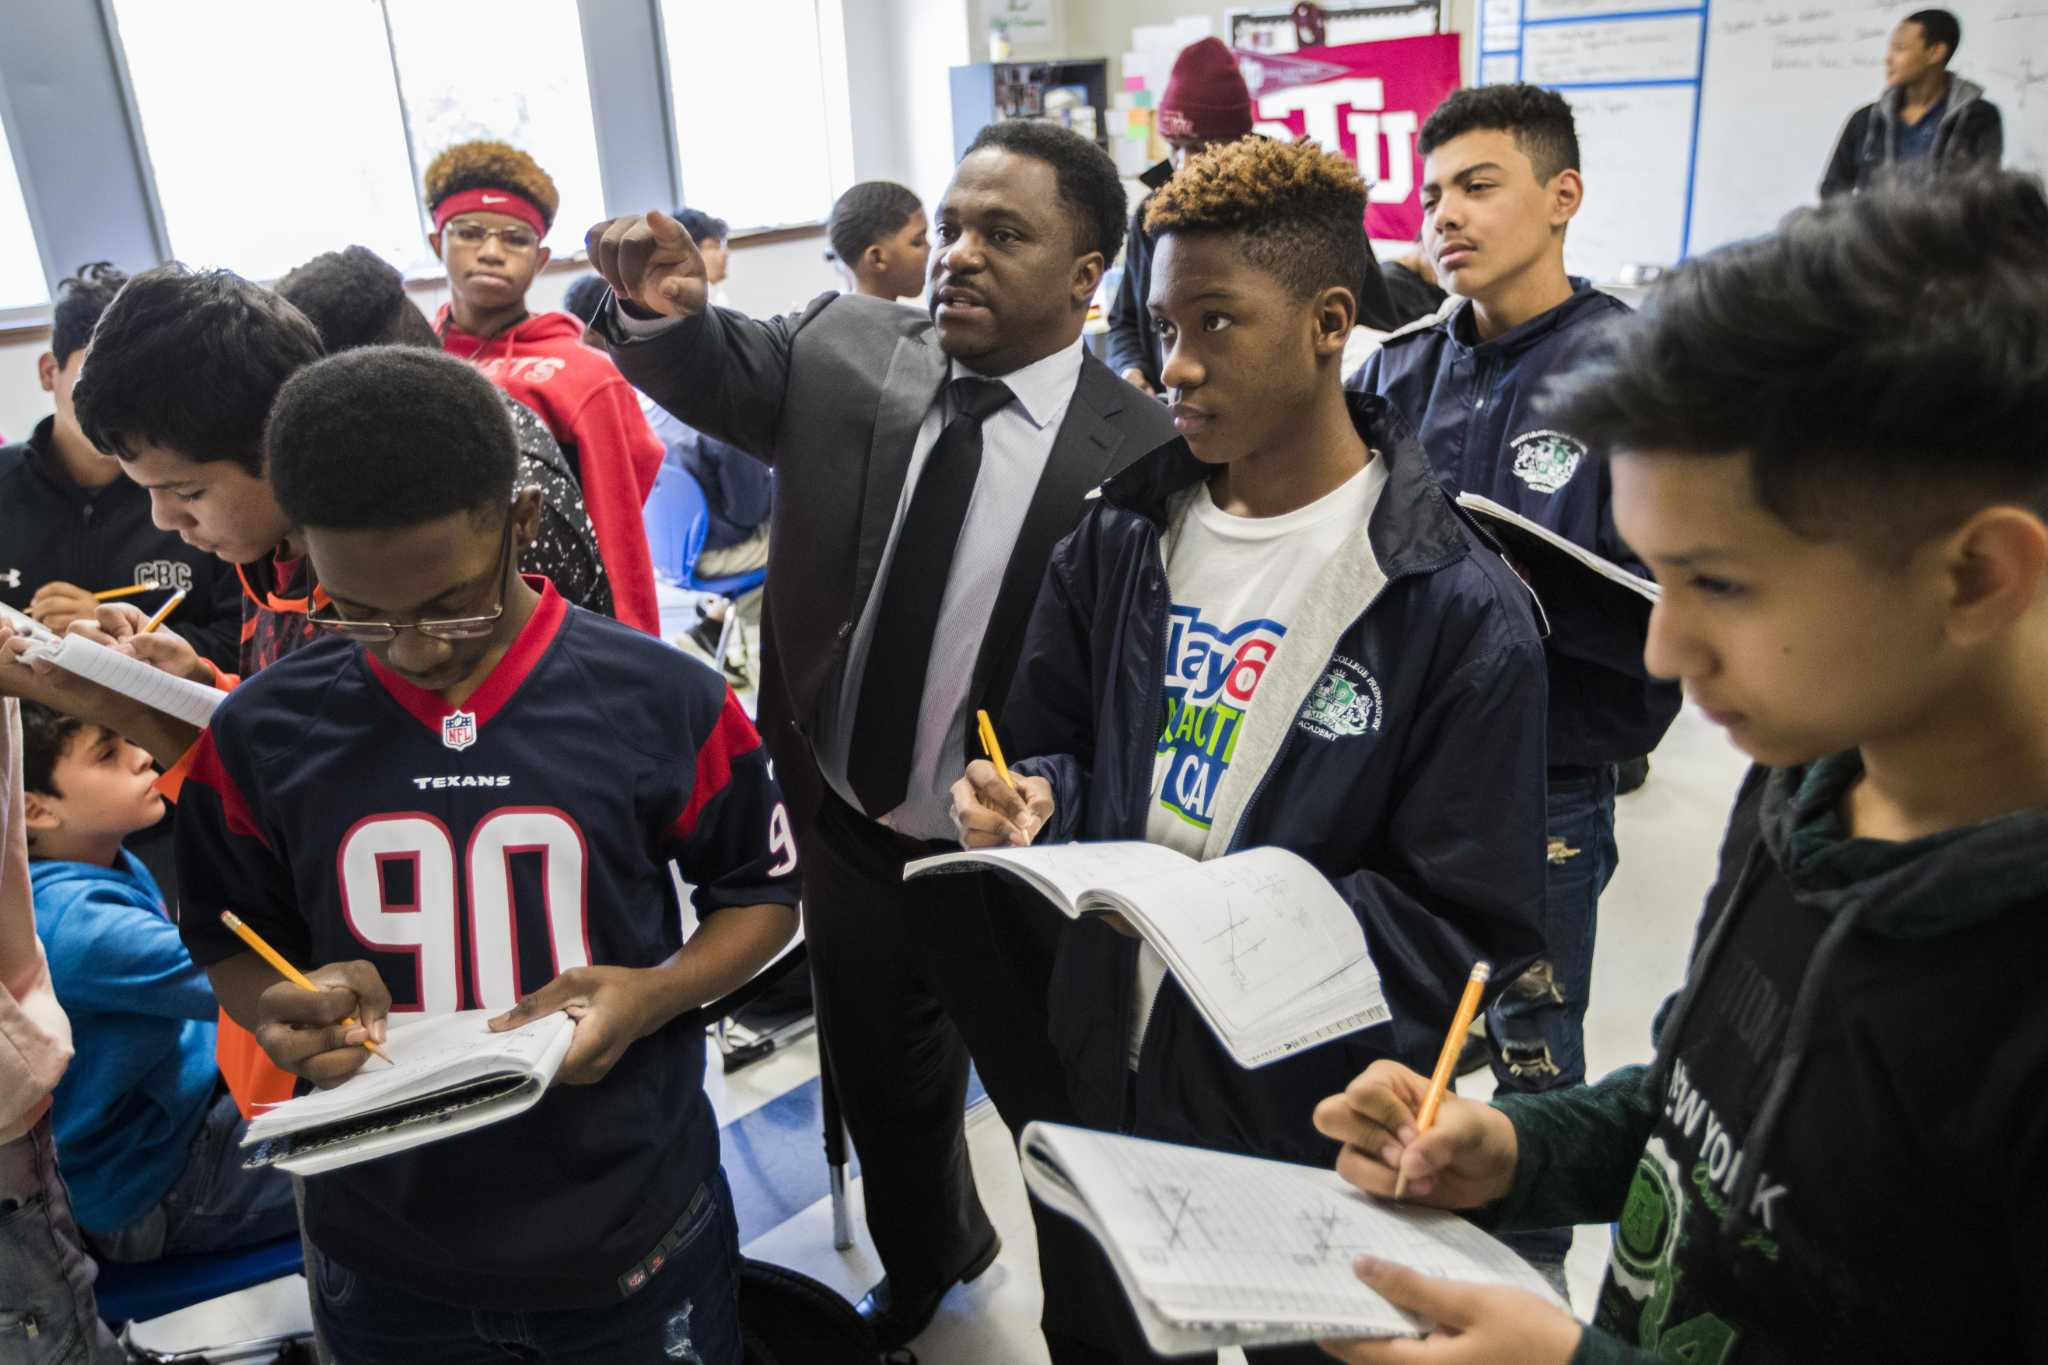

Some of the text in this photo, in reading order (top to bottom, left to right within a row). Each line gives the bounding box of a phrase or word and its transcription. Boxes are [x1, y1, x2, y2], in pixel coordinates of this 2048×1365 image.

[133, 559, 193, 592] CBC
[447, 727, 471, 743] NFL
[1298, 720, 1340, 742] ACADEMY
[413, 774, 511, 790] TEXANS
[339, 806, 592, 1013] 90
